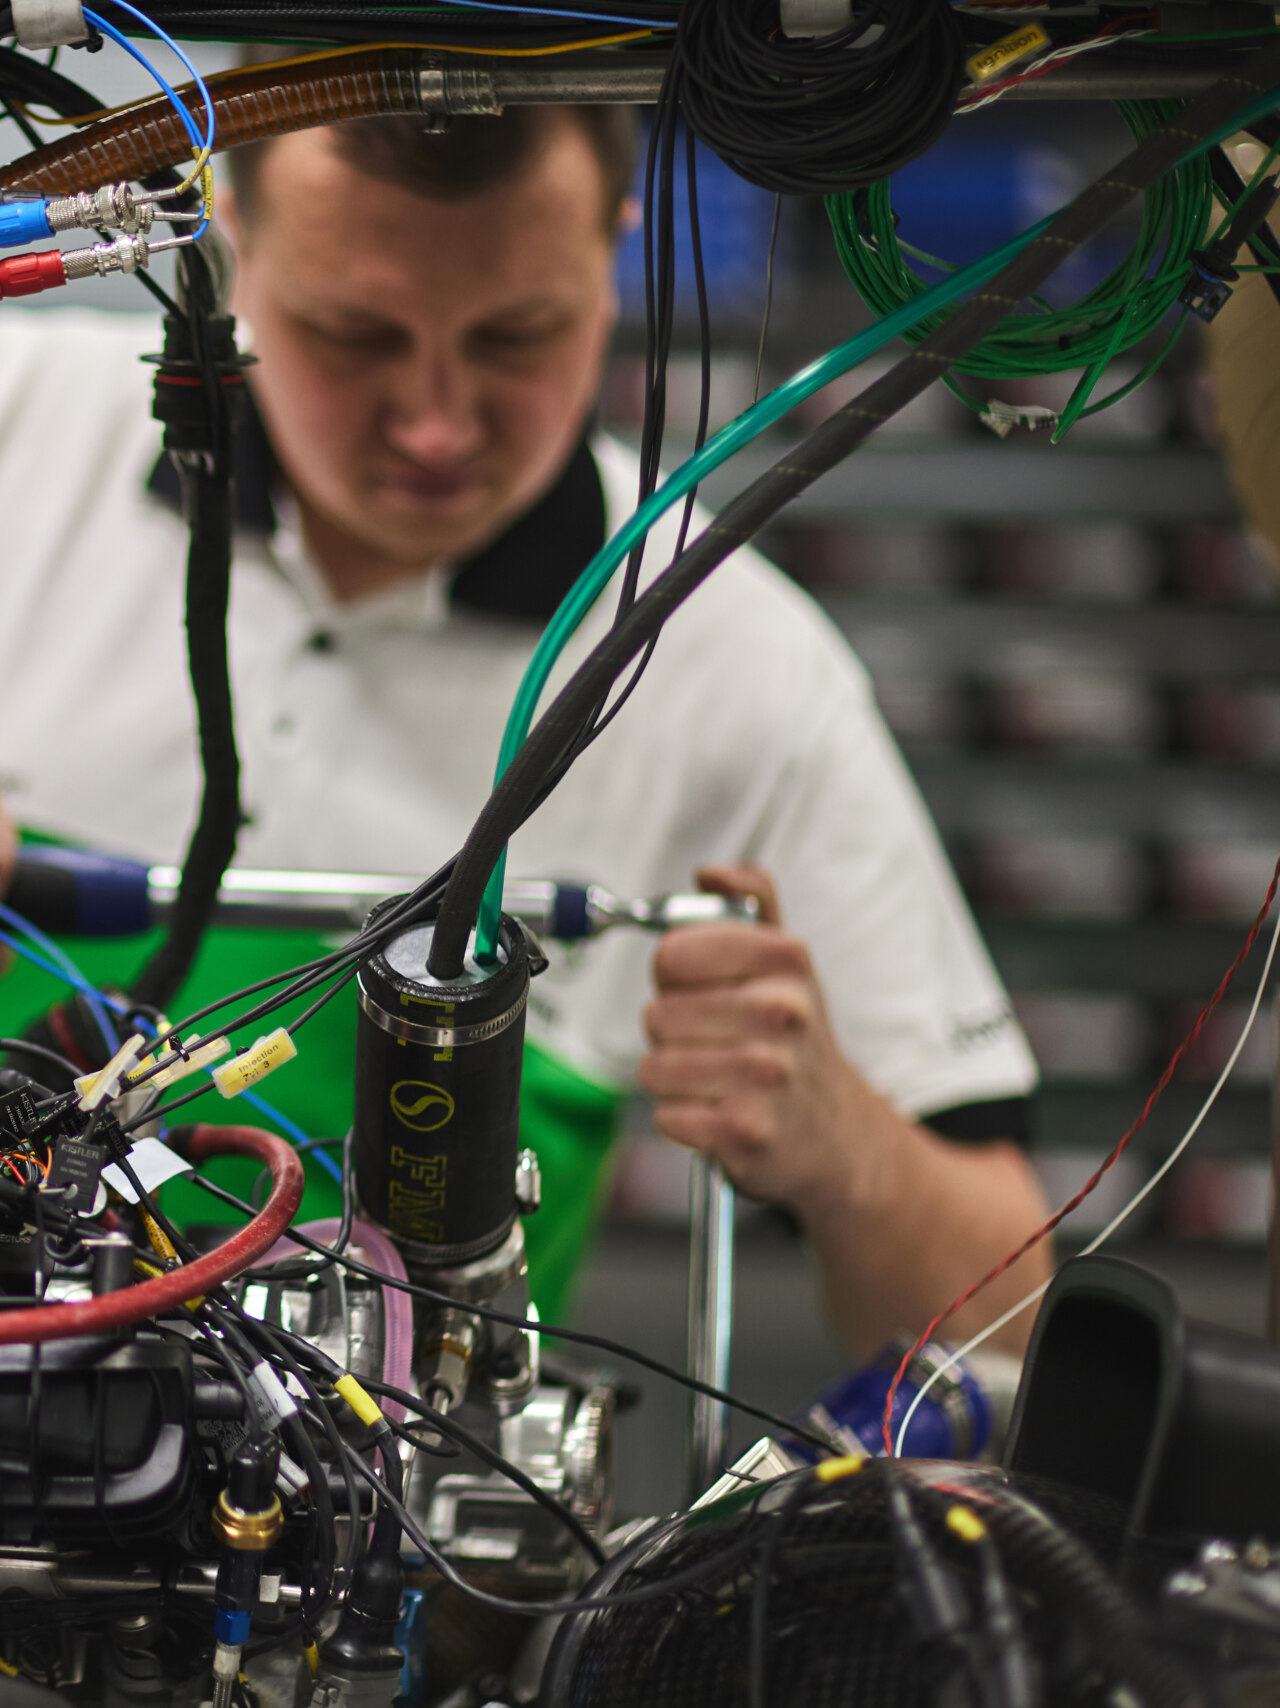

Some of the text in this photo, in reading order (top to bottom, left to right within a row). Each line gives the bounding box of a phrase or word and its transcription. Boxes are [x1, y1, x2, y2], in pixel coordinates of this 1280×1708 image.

[976, 31, 1039, 69] Ignition
[238, 1044, 279, 1073] Injection
[263, 1060, 270, 1069] 3
[61, 1143, 99, 1160] KISTLER
